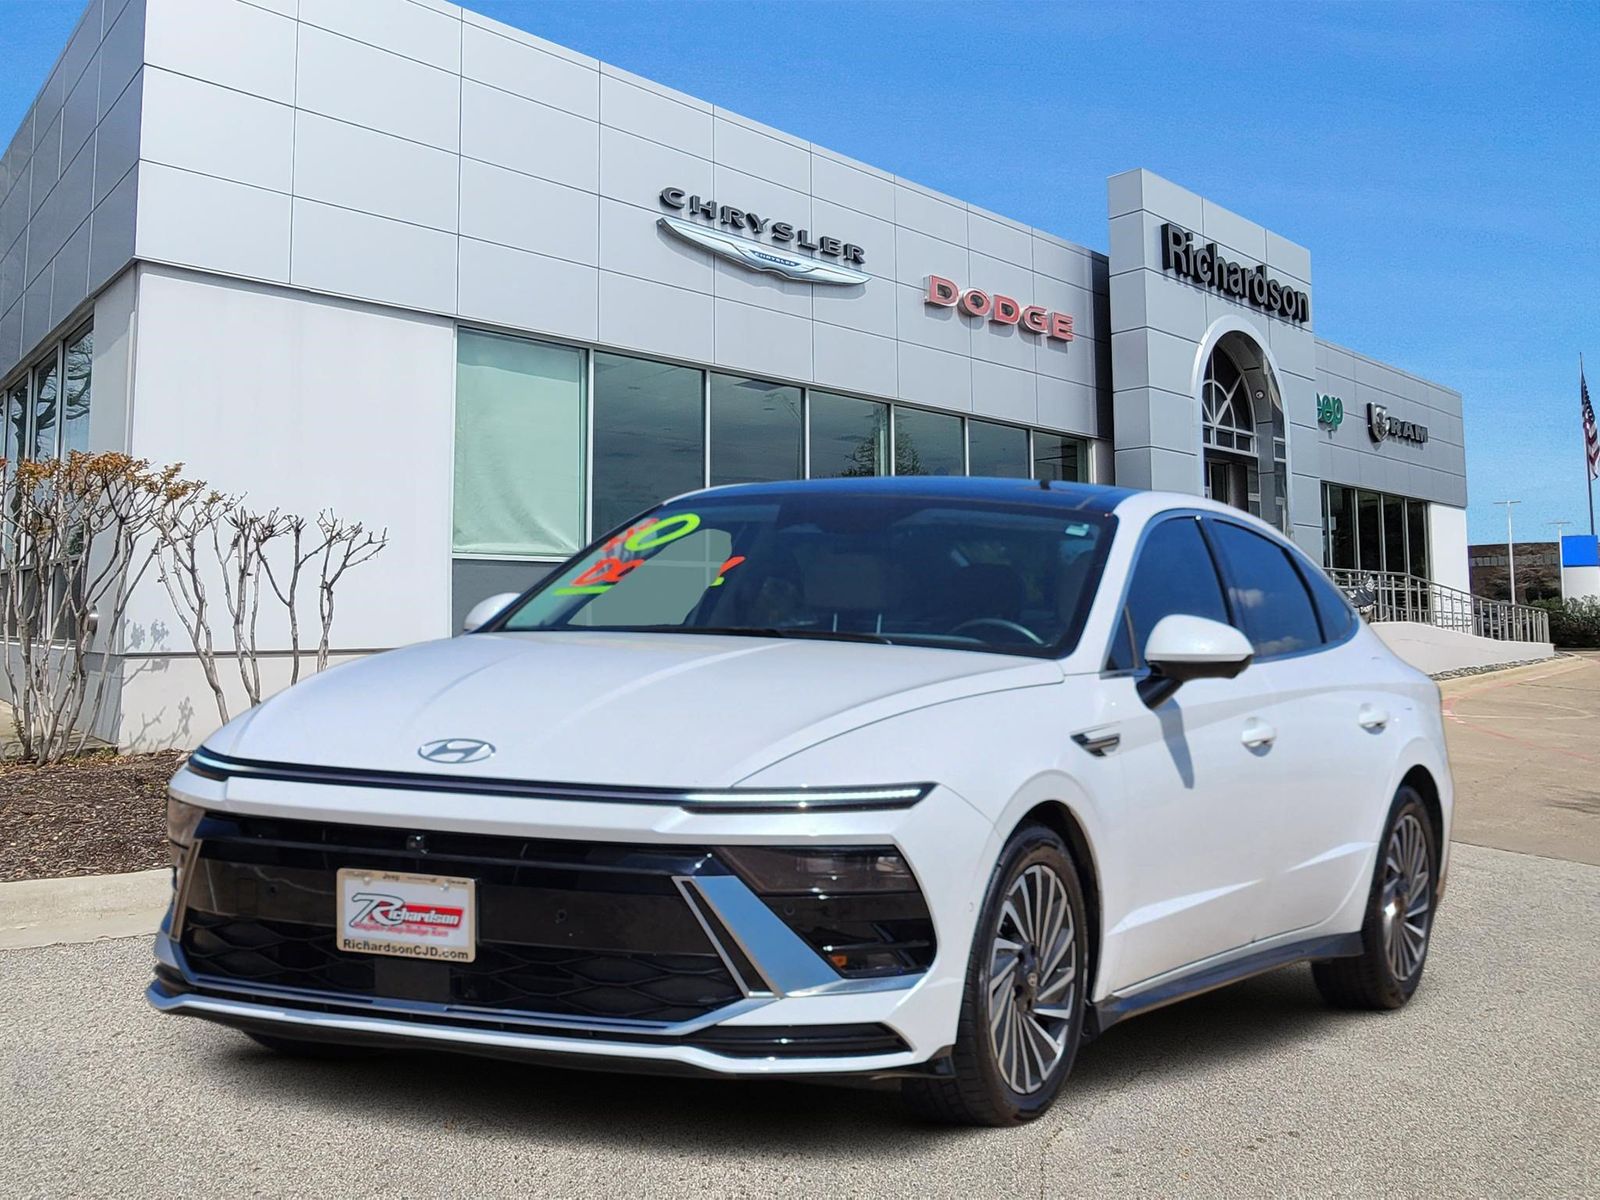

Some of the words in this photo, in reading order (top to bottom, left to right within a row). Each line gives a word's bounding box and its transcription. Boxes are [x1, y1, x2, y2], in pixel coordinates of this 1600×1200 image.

[659, 186, 866, 265] CHRYSLER
[1161, 223, 1310, 323] Richardson
[924, 274, 1075, 342] DODGE
[1387, 416, 1429, 443] RAM
[349, 892, 461, 928] Richardson
[343, 939, 468, 959] RichardsonCJD.com
